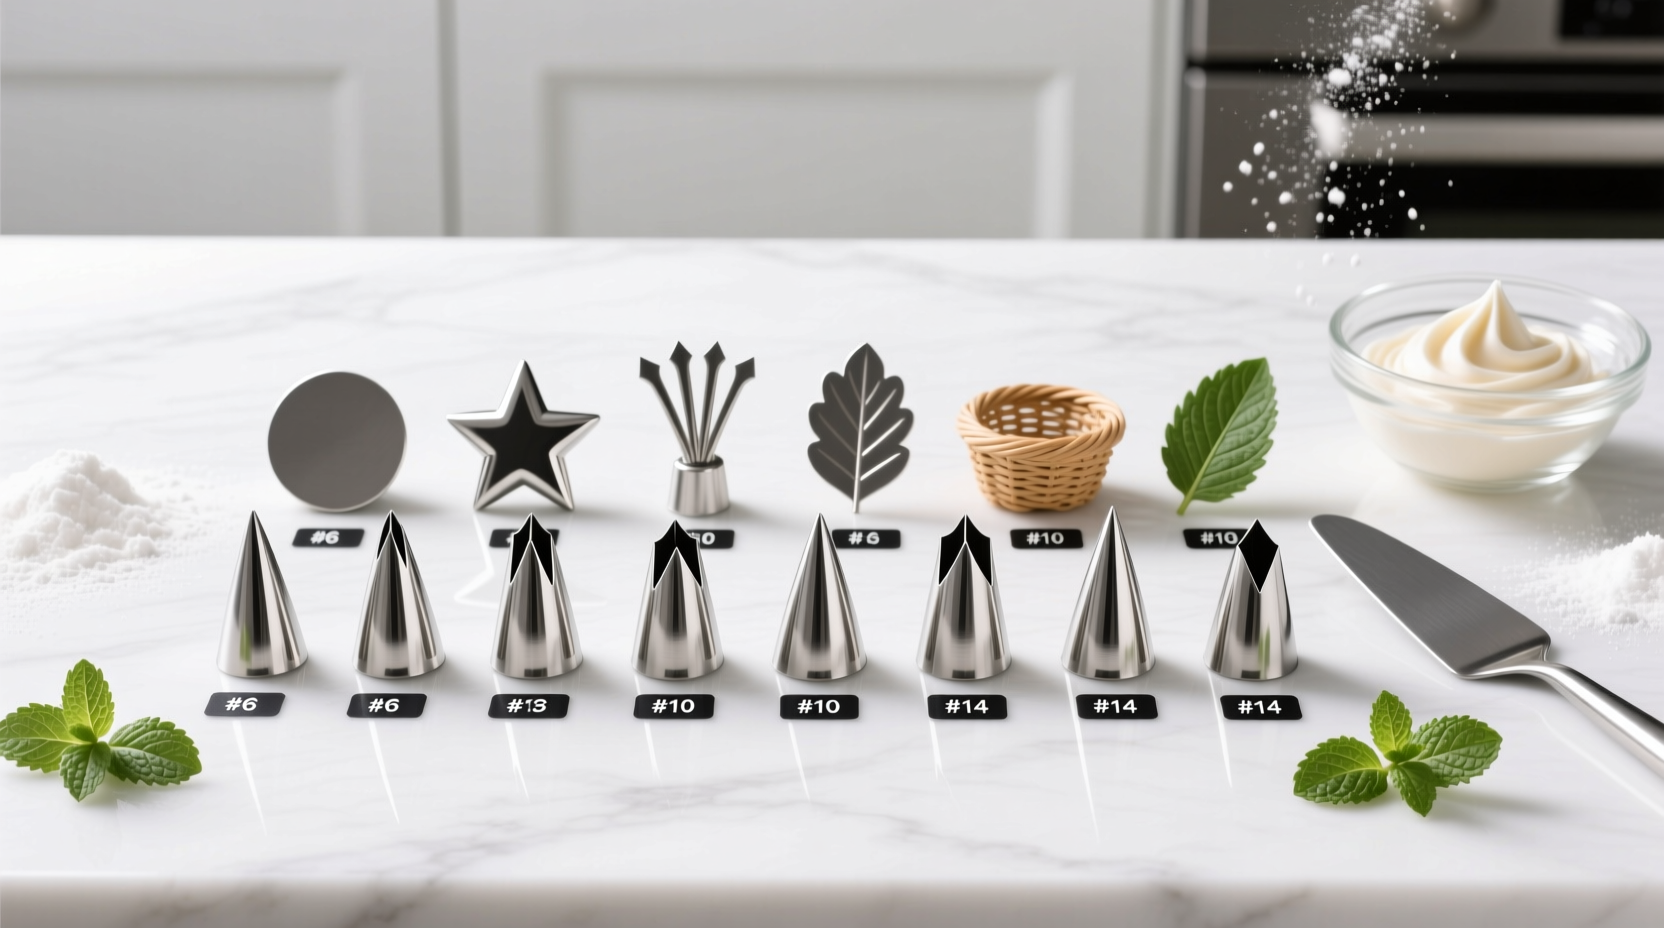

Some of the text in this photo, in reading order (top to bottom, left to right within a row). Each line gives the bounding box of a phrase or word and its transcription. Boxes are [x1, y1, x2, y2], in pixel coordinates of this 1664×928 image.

[310, 531, 339, 545] #6
[1026, 531, 1064, 545] #10
[1200, 531, 1238, 545] #10
[225, 697, 258, 711] #6
[368, 698, 399, 712] #6
[652, 699, 694, 713] #10
[798, 699, 840, 713] #10
[945, 699, 988, 713] #14
[1094, 699, 1137, 713] #14
[1238, 700, 1281, 714] #14
